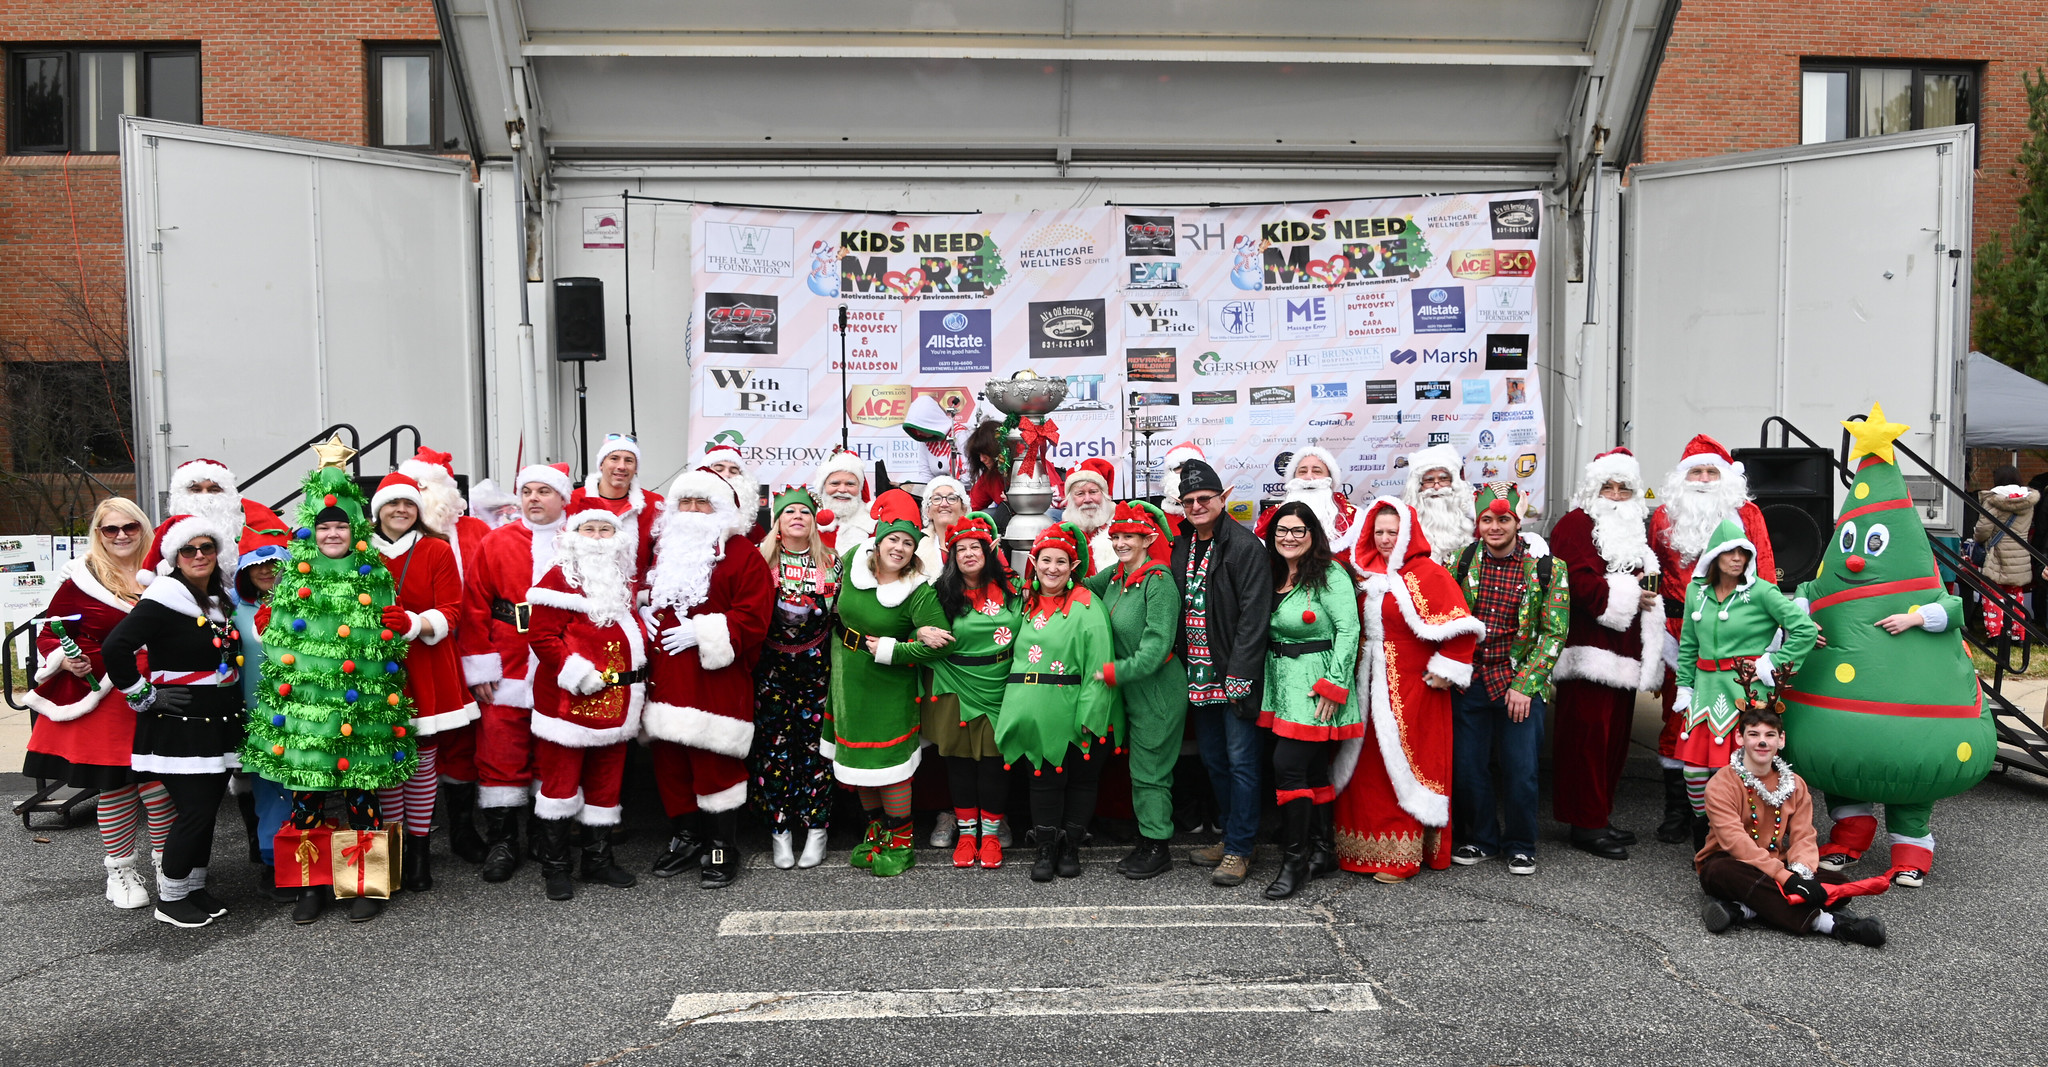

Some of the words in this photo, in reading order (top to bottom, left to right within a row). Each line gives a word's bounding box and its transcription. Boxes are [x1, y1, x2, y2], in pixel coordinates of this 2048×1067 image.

[1427, 213, 1478, 222] HEALTHCARE
[1131, 225, 1171, 237] 495
[1333, 217, 1408, 240] NEED
[913, 232, 984, 253] NEED
[1181, 222, 1225, 251] RH
[1020, 246, 1094, 258] HEALTHCARE
[708, 256, 727, 265] THE
[730, 257, 738, 265] H.
[753, 259, 791, 268] WILSON
[1020, 257, 1082, 268] WELLNESS
[1456, 259, 1491, 273] ACE
[718, 263, 781, 275] FOUNDATION
[1265, 283, 1311, 292] Motivational
[1312, 281, 1345, 290] Recovery
[1347, 278, 1399, 287] Environments,
[1356, 293, 1385, 301] CAROLE
[1053, 307, 1061, 317] Oil
[1062, 305, 1083, 316] Service
[1129, 302, 1178, 317] With
[1347, 301, 1395, 310] RUTKOVSKY
[1417, 304, 1459, 316] Allstate
[710, 307, 775, 324] 495
[844, 311, 885, 321] CAROLE
[1150, 318, 1195, 332] Pride
[1349, 327, 1397, 336] DONALDSON
[925, 334, 983, 348] Allstate
[851, 349, 878, 358] CARA
[1322, 347, 1380, 358] BRUNSWICK
[1423, 348, 1478, 364] Marsh
[832, 360, 898, 371] DONALDSON
[1204, 359, 1279, 372] GERSHOW
[1289, 354, 1316, 366] BHC
[709, 367, 779, 391] With
[737, 392, 803, 413] Pride
[857, 396, 907, 416] ACE
[737, 446, 828, 460] ERSHOW
[786, 567, 801, 578] OH
